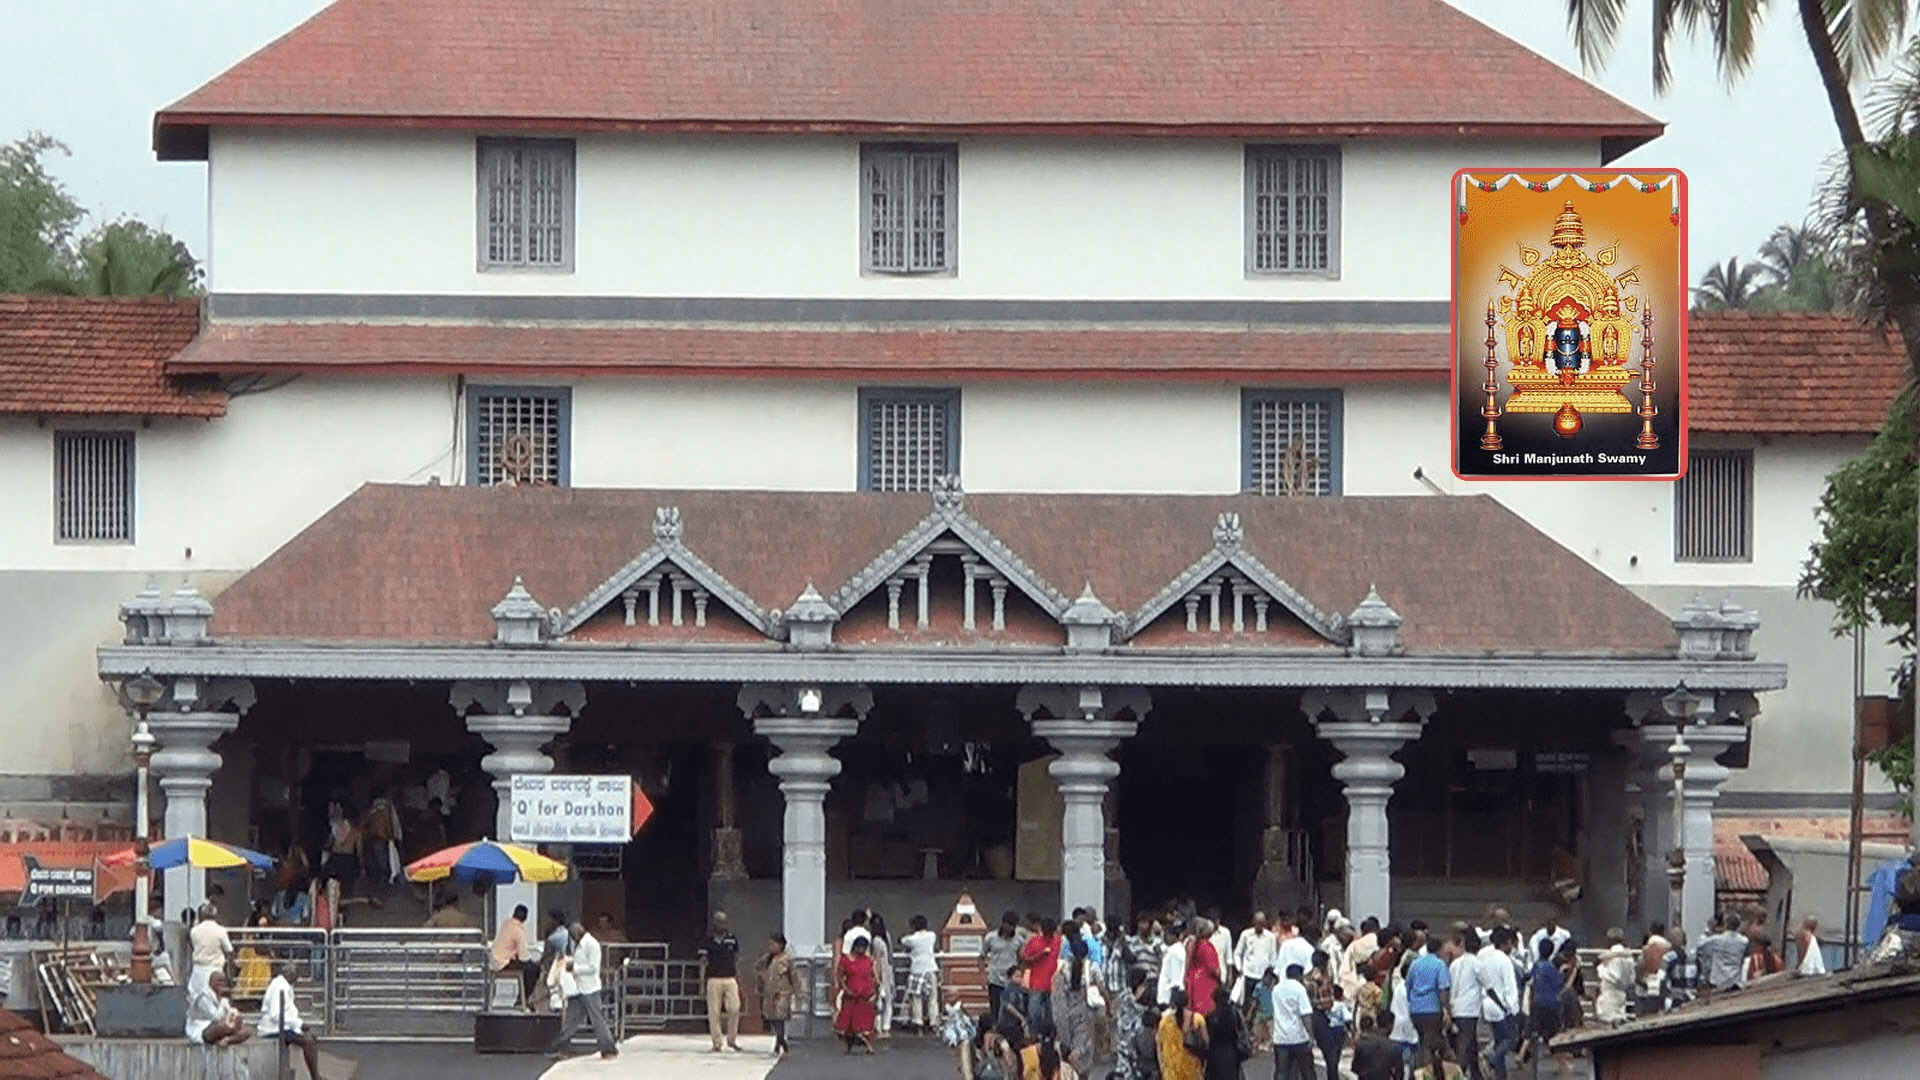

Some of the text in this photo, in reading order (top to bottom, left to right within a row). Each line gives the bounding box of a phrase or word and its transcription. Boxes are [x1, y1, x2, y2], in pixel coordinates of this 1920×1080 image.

[538, 800, 559, 816] for
[565, 801, 624, 816] Darshan
[39, 885, 53, 894] FOR
[56, 885, 92, 894] DARSHAN
